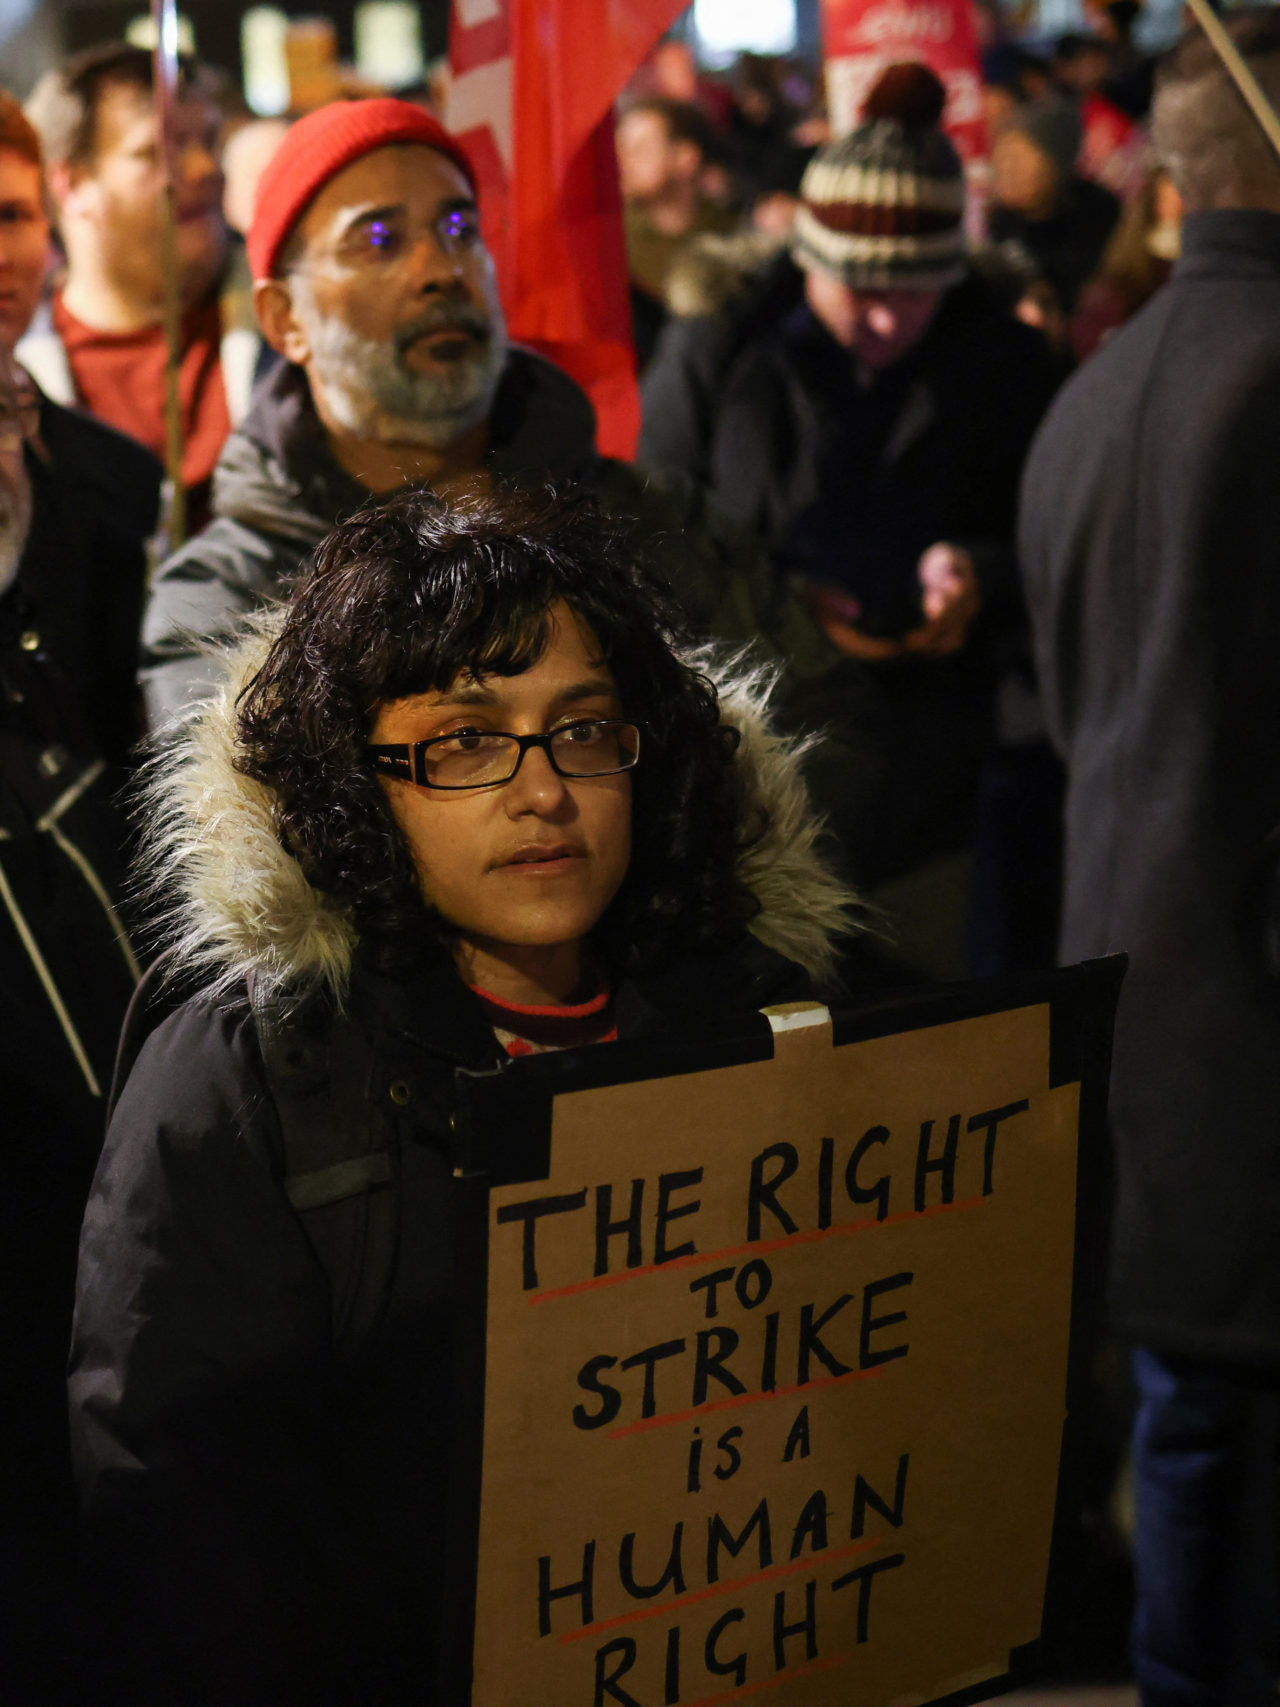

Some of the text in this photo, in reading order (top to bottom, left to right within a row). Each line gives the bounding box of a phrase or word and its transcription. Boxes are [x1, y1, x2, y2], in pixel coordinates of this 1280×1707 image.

[497, 1098, 1030, 1290] THE RIGHT
[572, 1271, 914, 1430] STRIKE
[689, 1258, 773, 1318] TO
[781, 1405, 811, 1463] A
[536, 1453, 910, 1638] HUMAN
[592, 1553, 905, 1707] RIGHT
